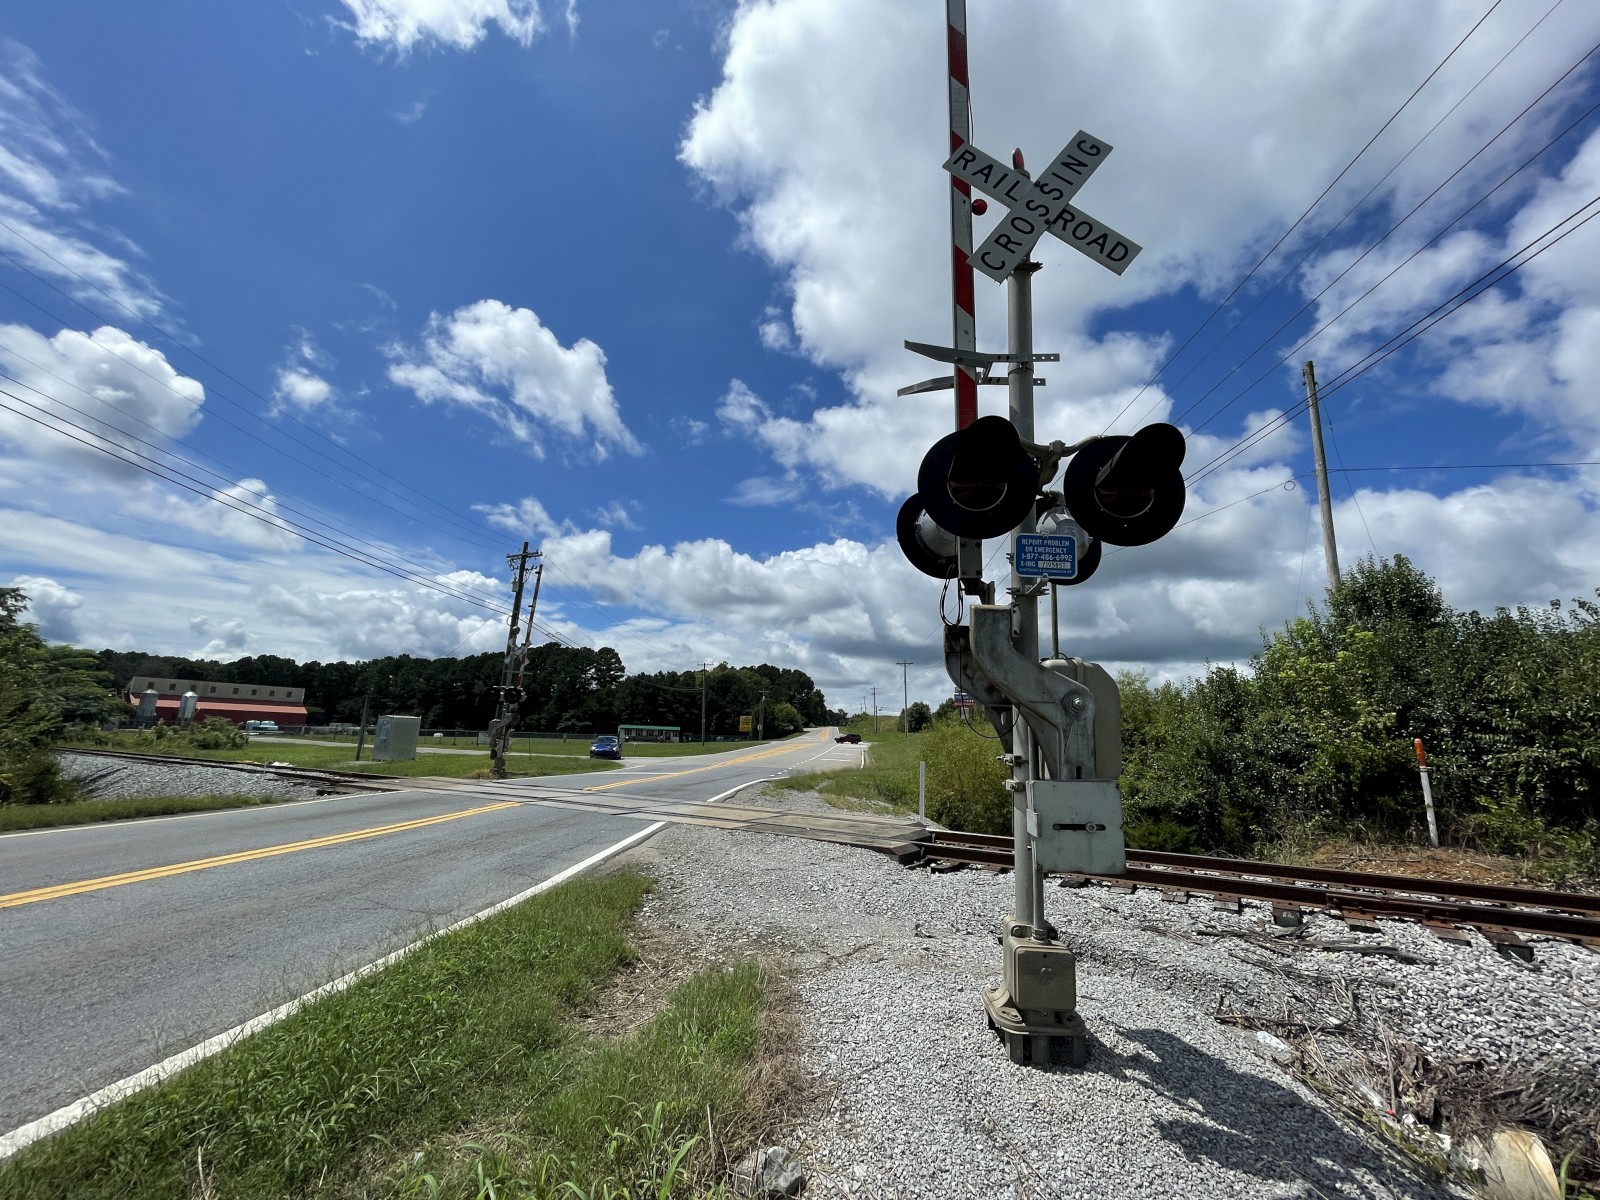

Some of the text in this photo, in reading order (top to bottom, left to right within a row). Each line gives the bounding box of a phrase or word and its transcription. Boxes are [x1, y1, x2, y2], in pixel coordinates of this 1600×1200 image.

[952, 148, 1129, 263] RAIL ROAD
[980, 139, 1101, 271] CROSSING
